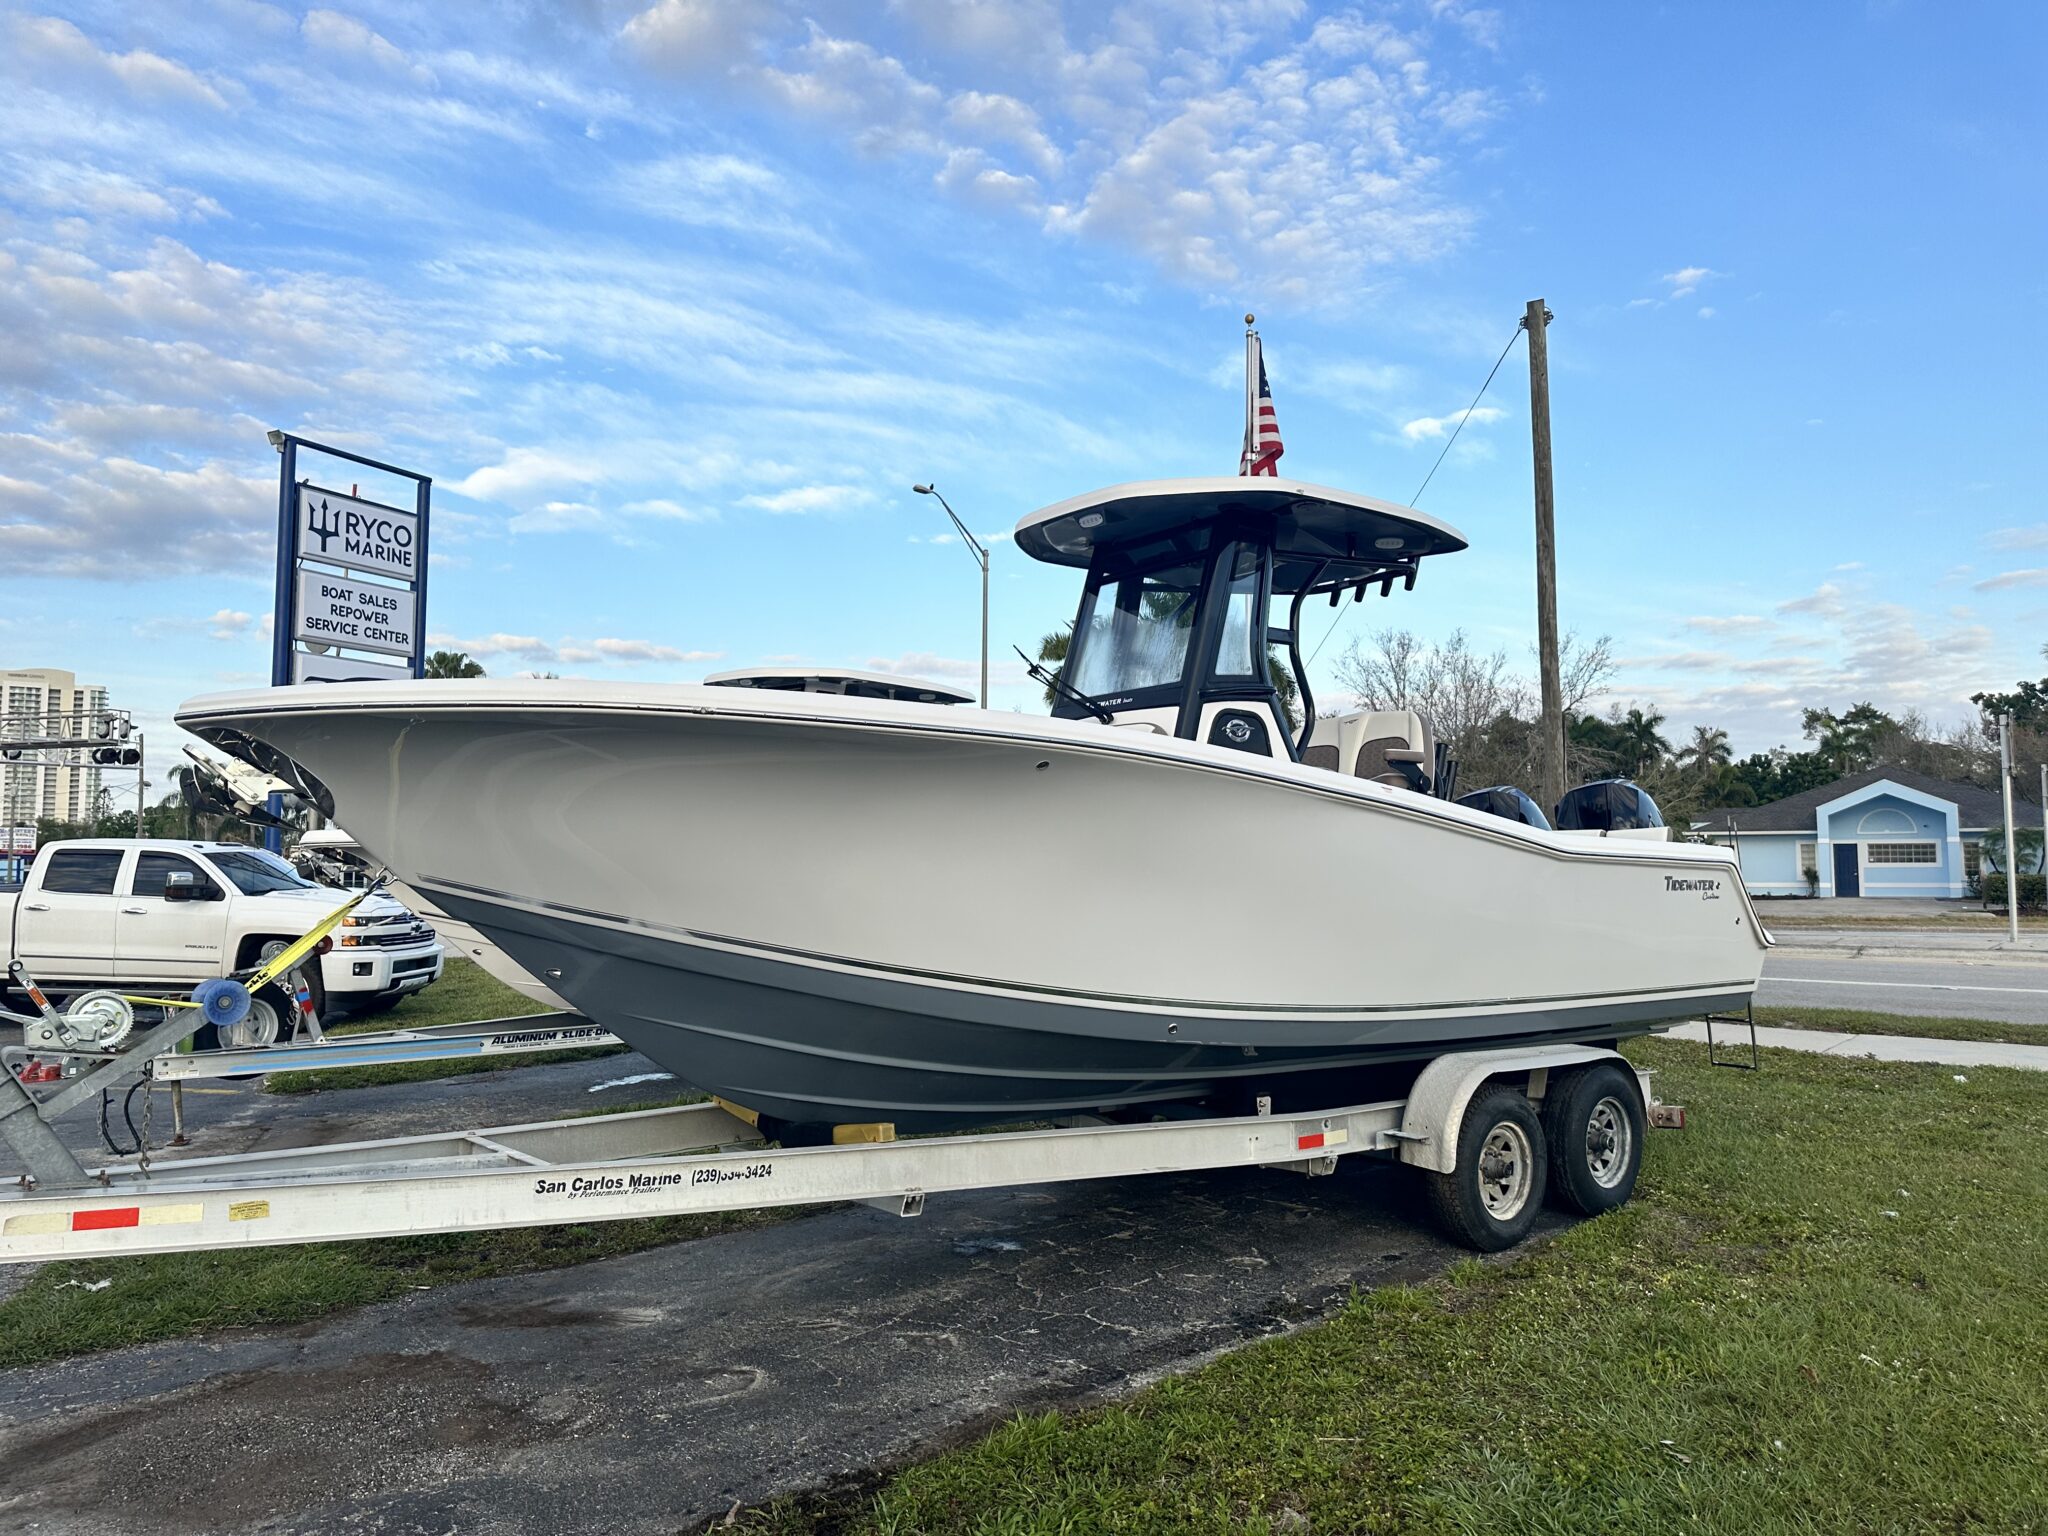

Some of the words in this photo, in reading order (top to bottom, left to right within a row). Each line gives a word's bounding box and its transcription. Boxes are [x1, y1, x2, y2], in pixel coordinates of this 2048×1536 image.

[345, 511, 412, 547] RYCO
[345, 536, 412, 567] MARINE
[321, 585, 353, 602] BOAT
[359, 592, 398, 611] SALES
[330, 603, 389, 625] REPOWER
[305, 616, 359, 637] SERVICE
[364, 626, 410, 645] CENTER
[1664, 875, 1715, 891] TIDEWATER
[491, 1031, 558, 1045] ALUMINUM
[561, 1028, 611, 1039] SLIDE-ON
[535, 1179, 567, 1194] San
[571, 1176, 624, 1192] Carlos
[629, 1171, 682, 1188] Marine
[567, 1191, 577, 1199] by
[579, 1188, 630, 1198] Performance
[631, 1186, 662, 1194] Trailers
